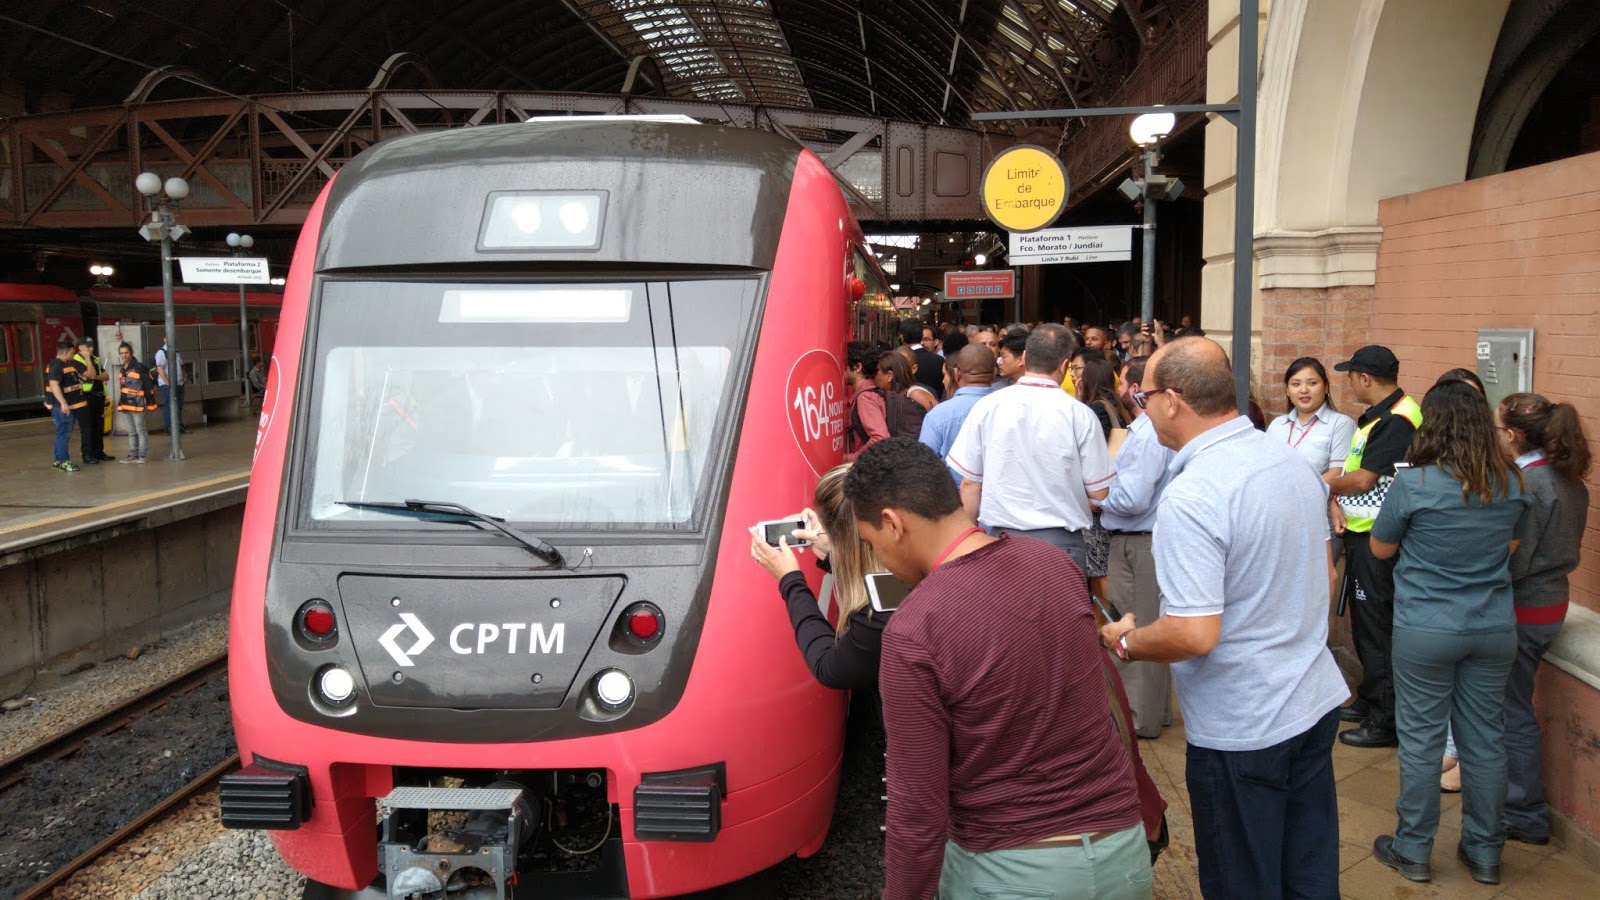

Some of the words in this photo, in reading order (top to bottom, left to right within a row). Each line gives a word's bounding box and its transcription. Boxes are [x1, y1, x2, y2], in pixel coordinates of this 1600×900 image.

[1007, 167, 1041, 180] Limite
[1017, 183, 1032, 194] de
[1019, 235, 1065, 243] Plataforma
[1037, 243, 1068, 251] Morato
[830, 418, 844, 436] TRE
[449, 622, 565, 655] CPTM
